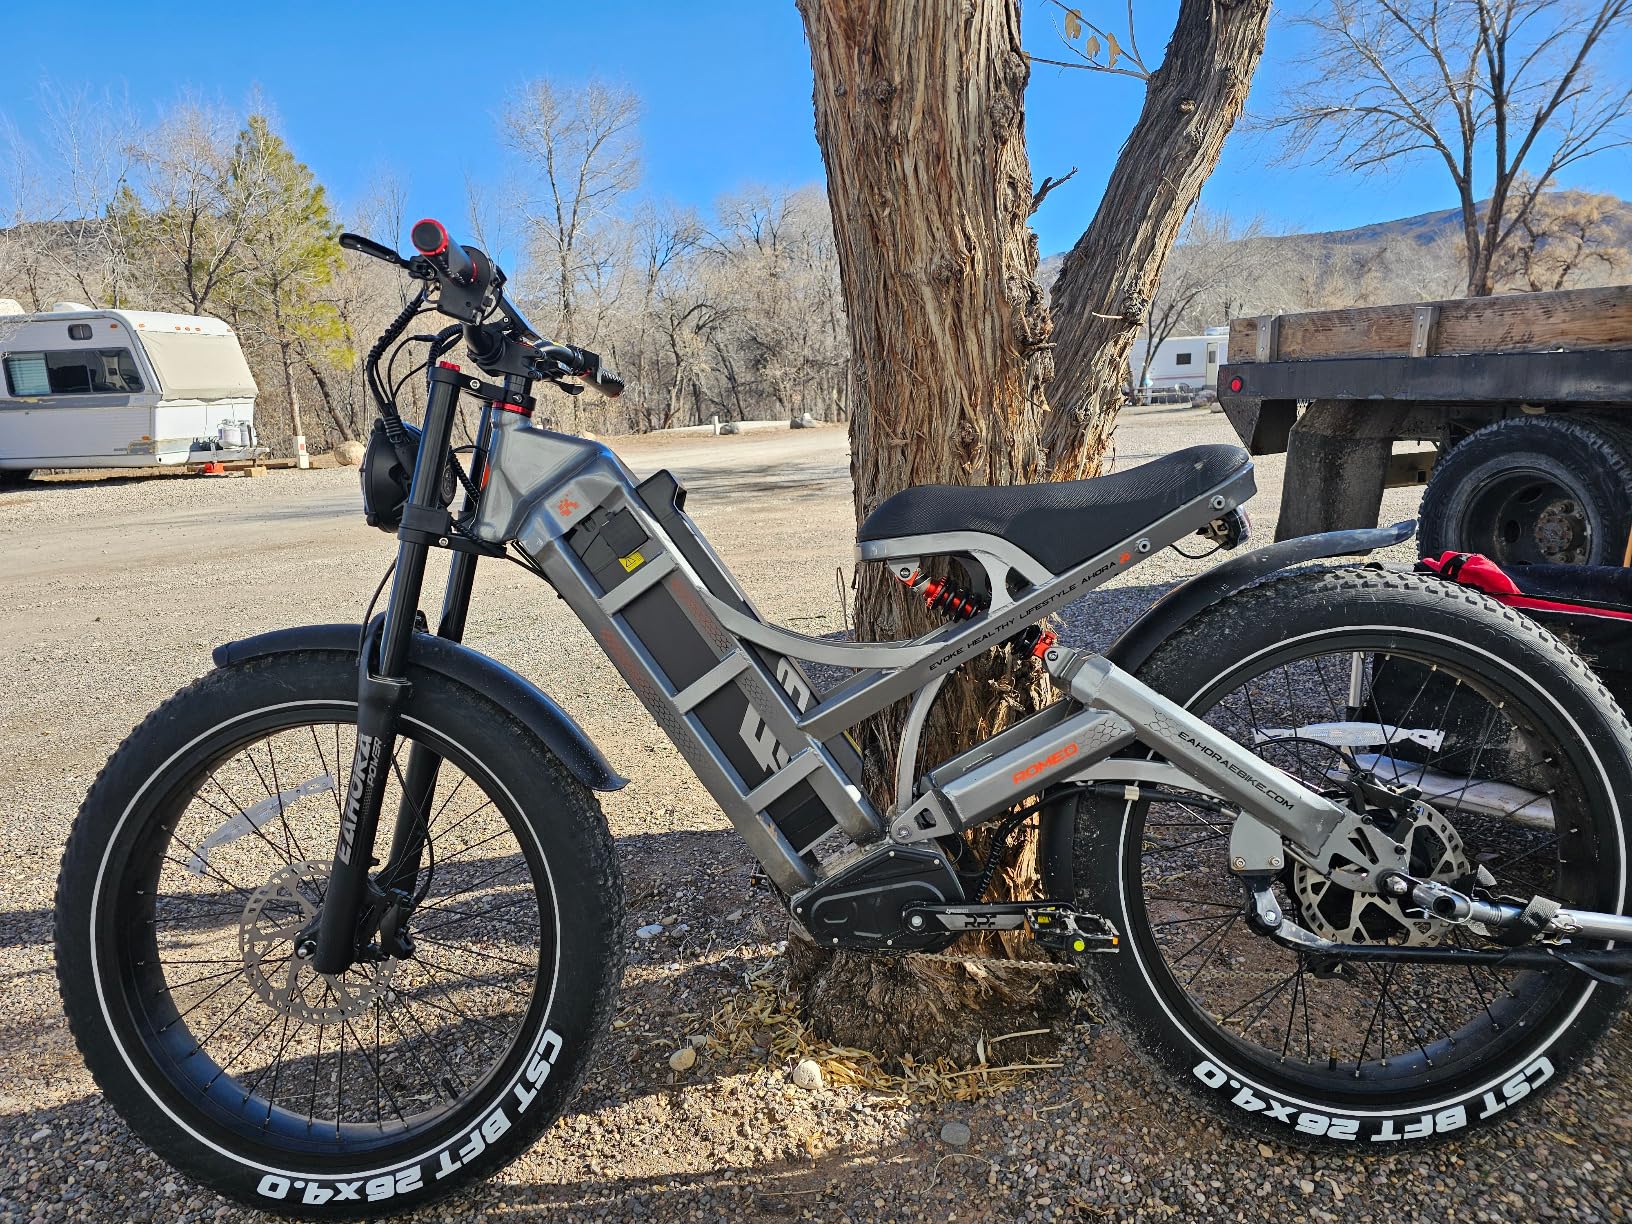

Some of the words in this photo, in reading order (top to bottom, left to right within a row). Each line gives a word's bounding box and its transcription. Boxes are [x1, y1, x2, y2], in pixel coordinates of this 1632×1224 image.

[929, 647, 964, 671] EVOKE
[967, 618, 1015, 649] HEALTHY
[1019, 583, 1077, 619] LIFESTYLE
[1081, 561, 1116, 584] AHORA
[367, 736, 382, 788] POWER
[1012, 742, 1078, 784] ROMEO
[1178, 731, 1295, 810] EAHORAEBIKE.COM
[513, 1028, 563, 1114] CST
[1479, 1056, 1555, 1120] CST
[435, 1107, 512, 1180] BFT
[1370, 1105, 1469, 1142] BFT
